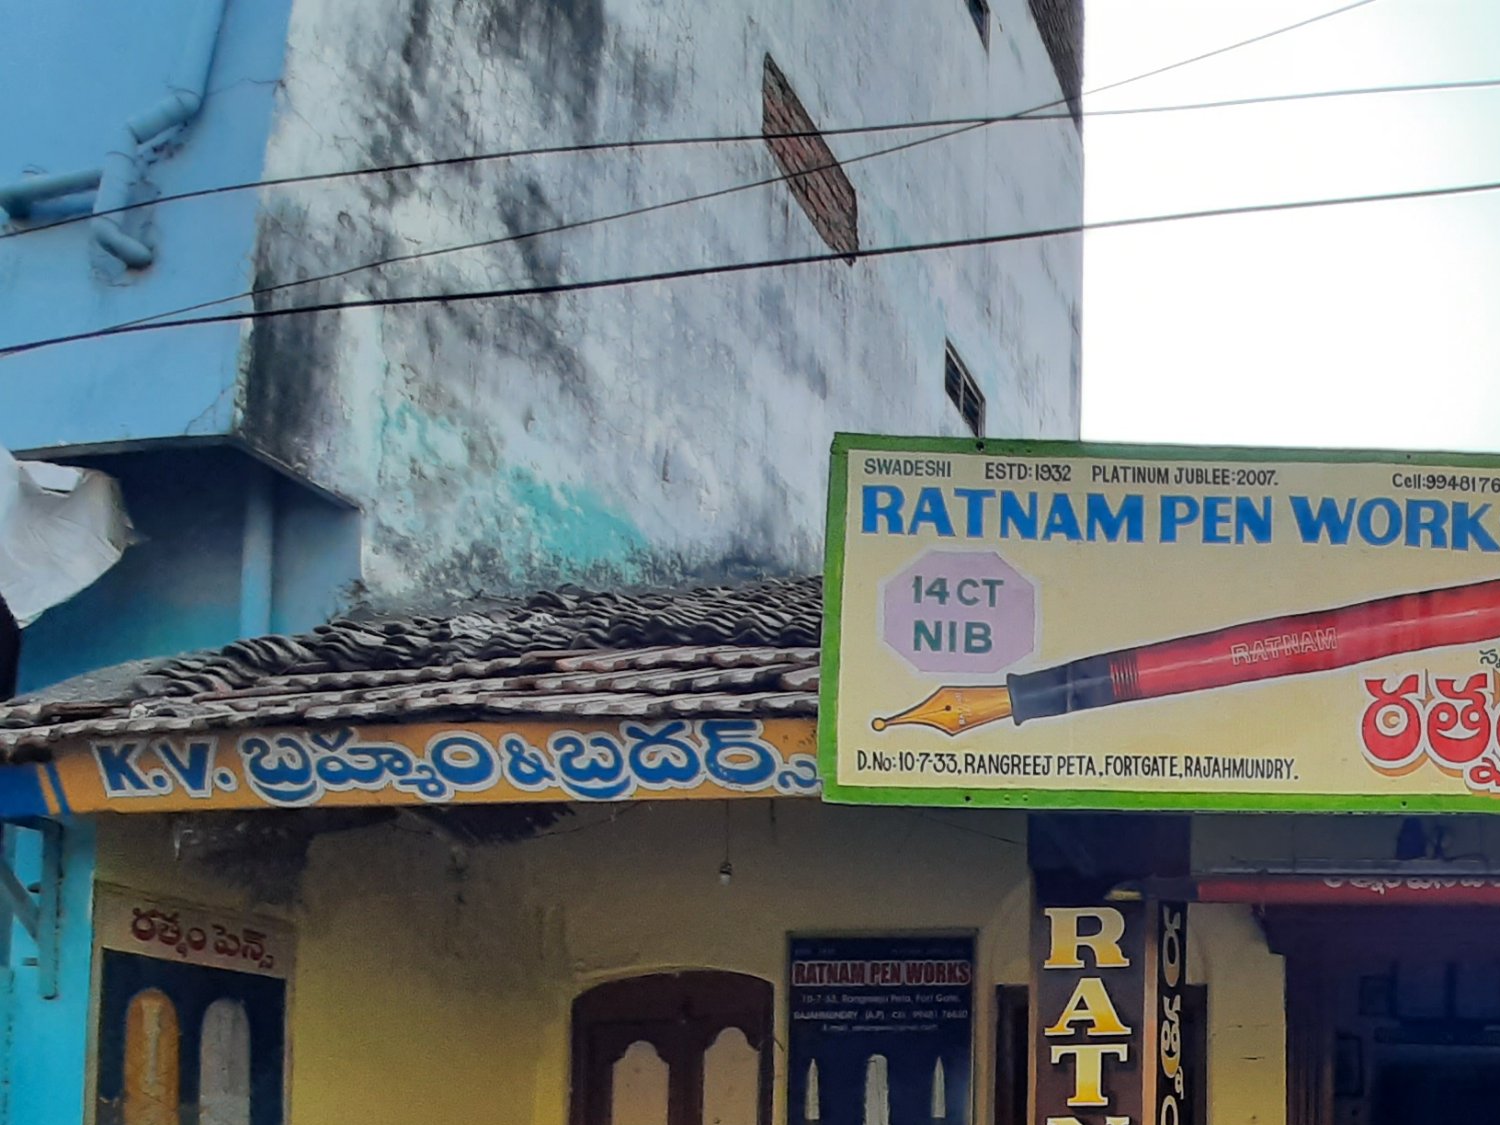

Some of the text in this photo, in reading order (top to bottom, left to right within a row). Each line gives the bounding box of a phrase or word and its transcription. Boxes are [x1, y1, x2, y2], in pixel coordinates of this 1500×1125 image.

[863, 458, 951, 478] SWADESHI
[1092, 466, 1170, 485] PLATINUM
[861, 485, 1144, 543] RATNAM
[1159, 494, 1272, 544] PEN
[913, 619, 993, 654] NIB
[1231, 628, 1338, 666] RATNAM
[794, 961, 972, 985] RATNAM PEN WORKS
